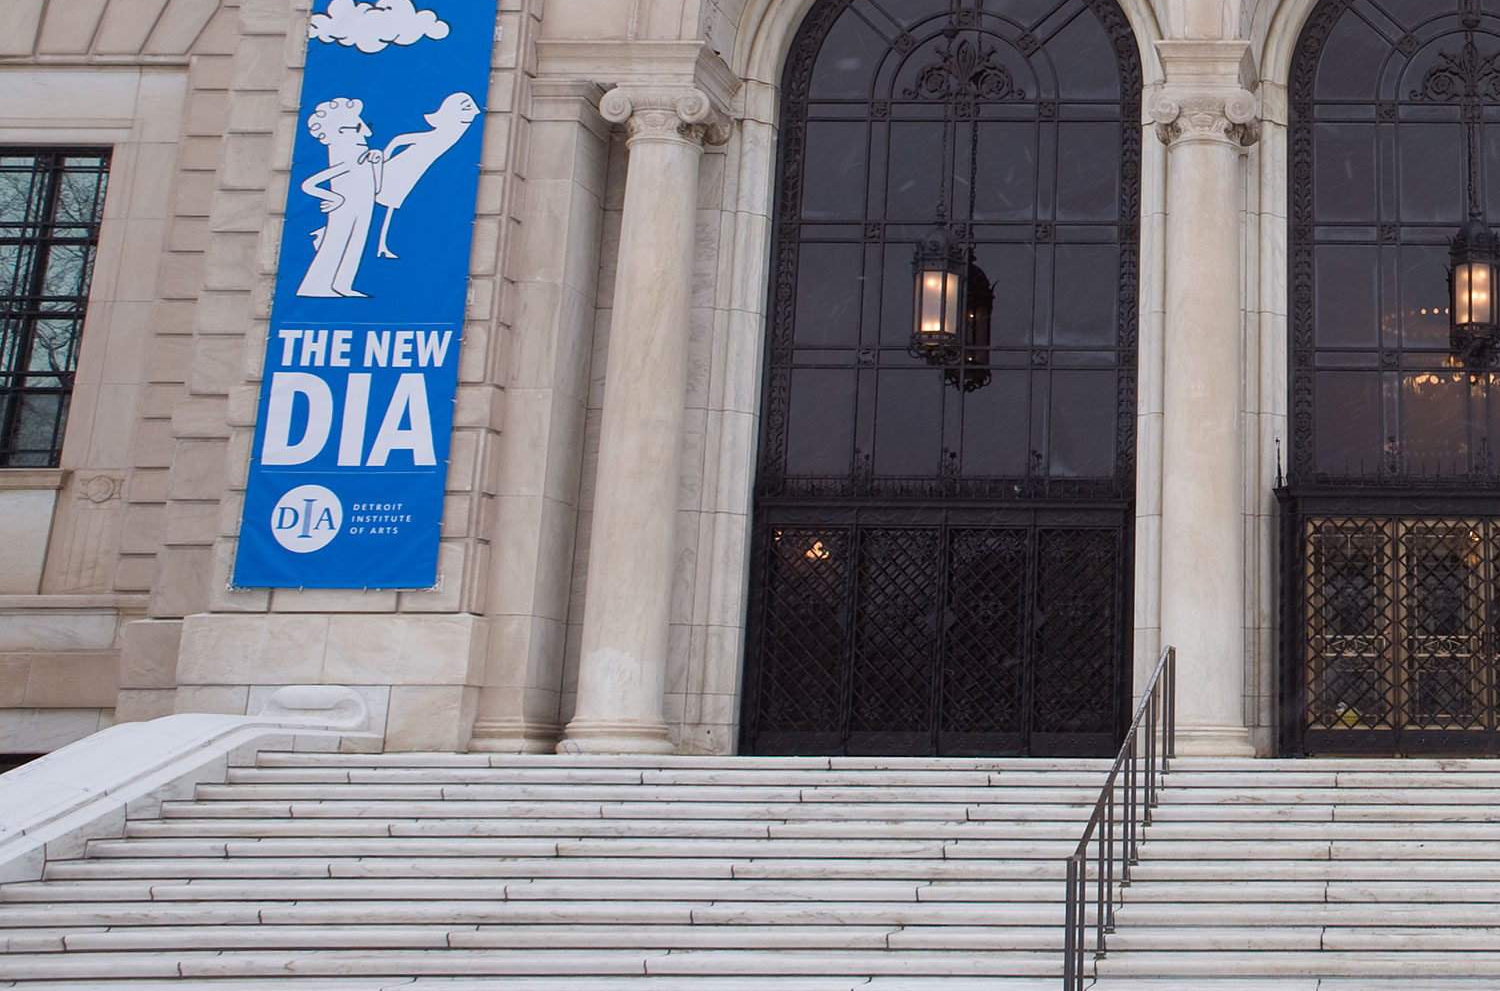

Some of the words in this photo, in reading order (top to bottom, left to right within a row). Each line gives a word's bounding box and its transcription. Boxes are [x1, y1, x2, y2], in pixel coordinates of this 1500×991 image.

[279, 330, 352, 366] THE
[364, 331, 452, 367] NEW
[261, 372, 437, 467] DIA
[275, 498, 337, 538] DIA
[351, 514, 411, 523] INSTITUTE
[353, 503, 402, 511] DETROIT
[349, 527, 364, 535] OF
